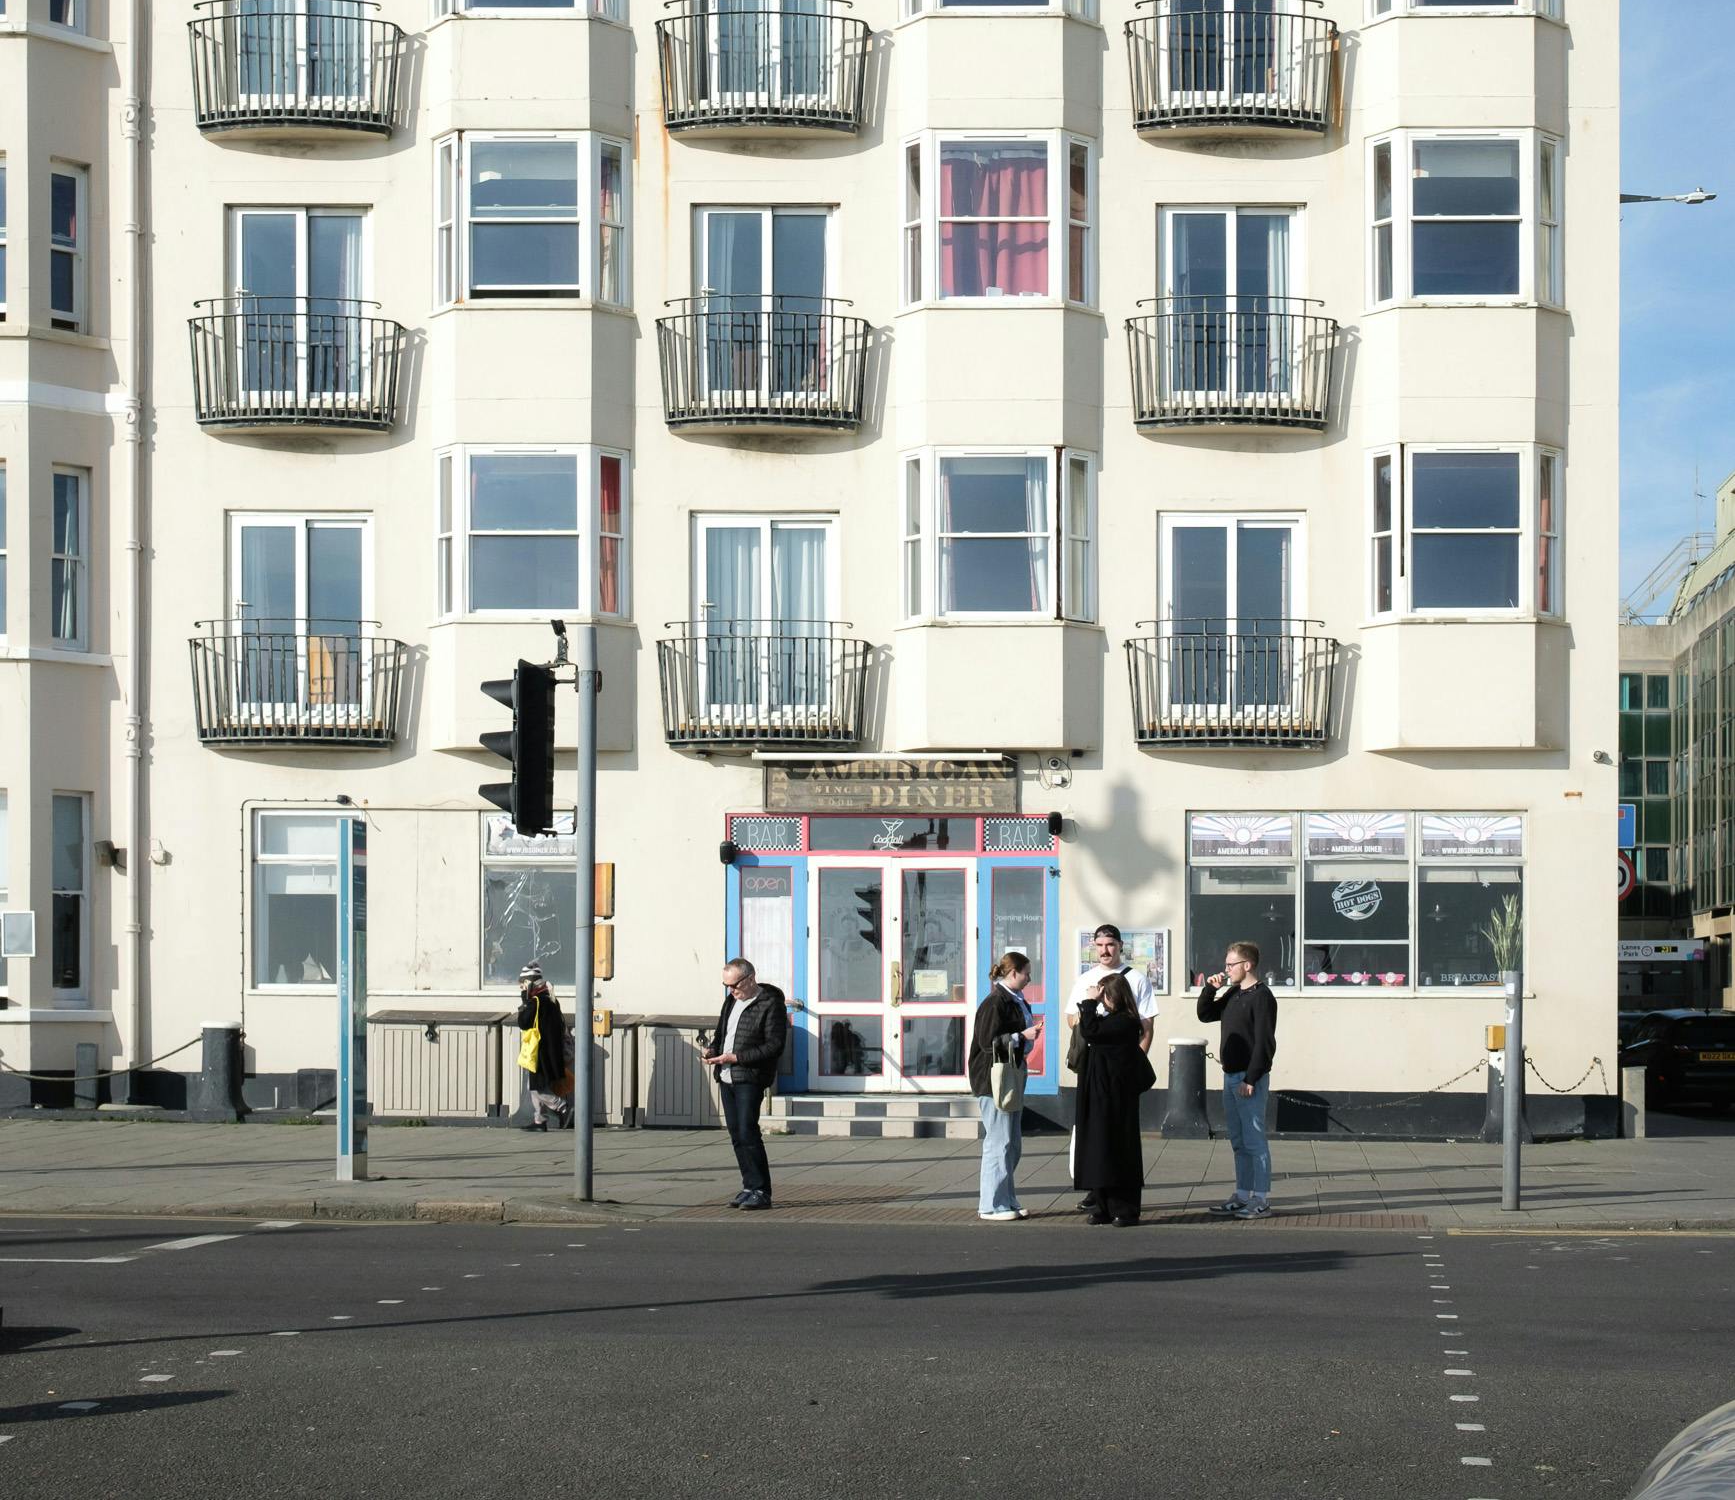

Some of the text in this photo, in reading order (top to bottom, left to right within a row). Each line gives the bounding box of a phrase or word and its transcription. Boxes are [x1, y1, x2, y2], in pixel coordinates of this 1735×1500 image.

[870, 785, 995, 808] DINER
[747, 823, 787, 847] BAR
[999, 824, 1038, 846] BAR
[1217, 847, 1249, 855] AMERICAN
[1331, 845, 1363, 853] AMERICAN
[744, 876, 787, 893] open
[1336, 897, 1356, 910] HOT
[1356, 891, 1380, 904] DOGS
